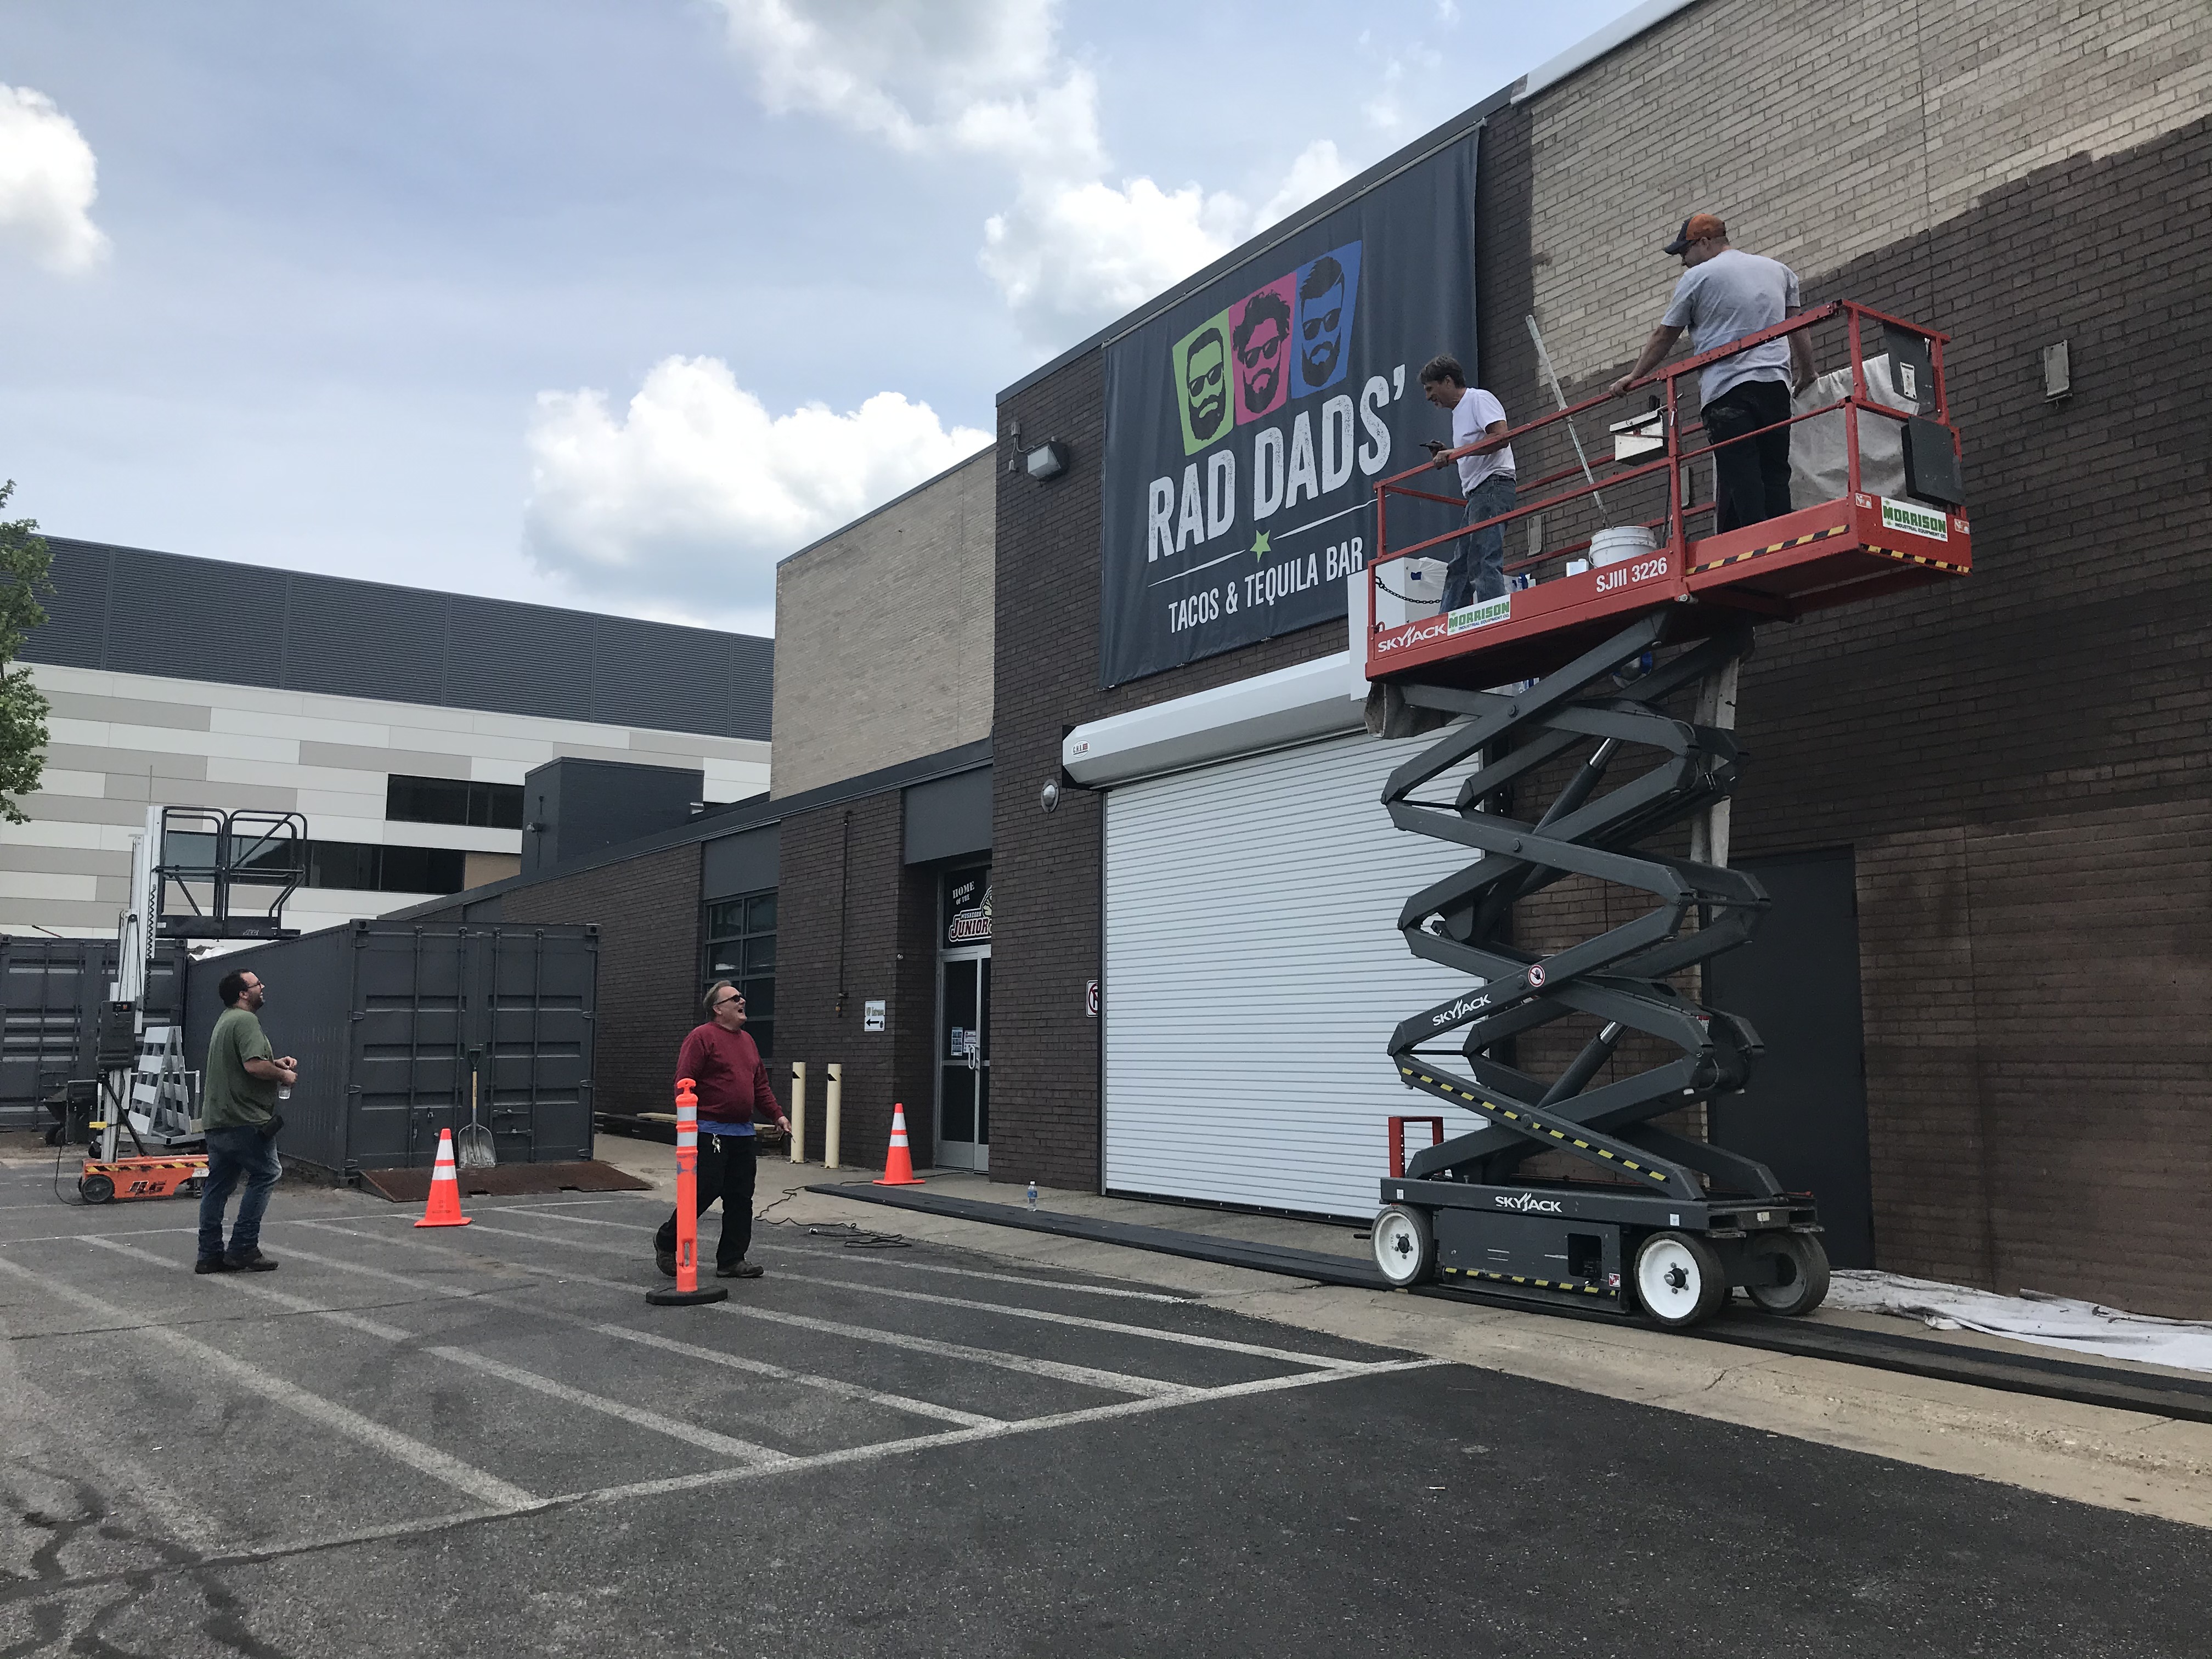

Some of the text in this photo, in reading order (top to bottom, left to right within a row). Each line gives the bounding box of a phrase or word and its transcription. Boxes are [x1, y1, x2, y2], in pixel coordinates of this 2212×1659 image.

[1148, 364, 1406, 563] RAD DADS'
[1883, 505, 1946, 533] MORRISON
[1895, 523, 1917, 532] INDUSTRIAL
[1918, 528, 1940, 537] EQUIPMENT
[1632, 557, 1667, 582] 3226
[1169, 537, 1363, 633] TACOS & TEQUILA BAR
[1449, 601, 1510, 628] MORRISON
[1459, 622, 1480, 630] INDUSTRIAL
[1481, 615, 1503, 624] EQUIPMENT
[1378, 623, 1446, 653] SKYJACK
[952, 881, 975, 899] HOME
[962, 894, 970, 902] THE
[1432, 994, 1492, 1026] SKYJACK
[129, 1180, 167, 1195] JLG
[1495, 1192, 1562, 1213] SKYJACK
